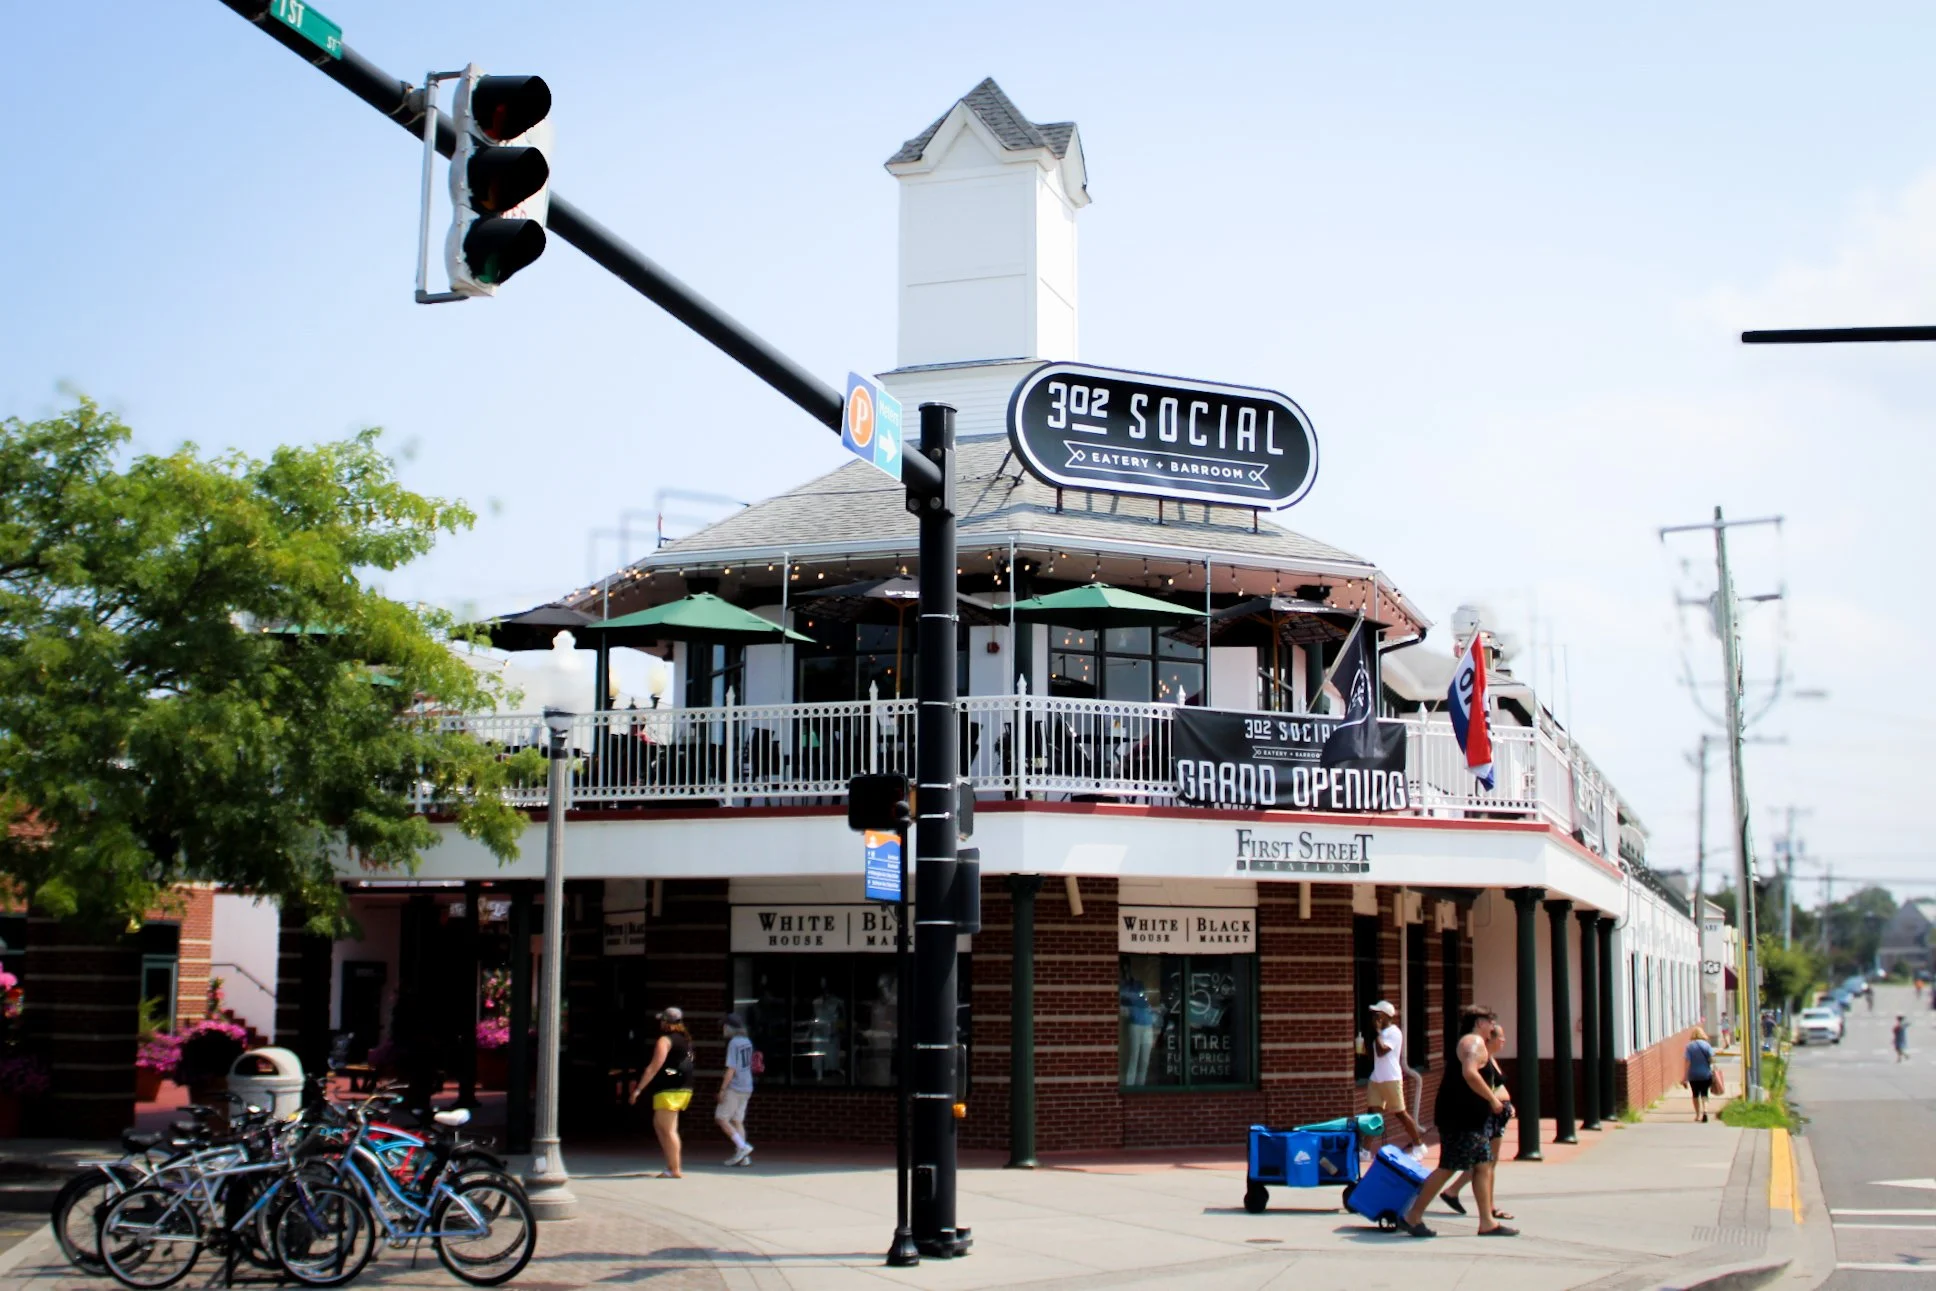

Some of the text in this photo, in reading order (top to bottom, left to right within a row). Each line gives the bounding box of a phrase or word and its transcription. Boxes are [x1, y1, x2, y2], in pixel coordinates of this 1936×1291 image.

[1047, 381, 1284, 455] 302 SOCIAL
[1092, 451, 1149, 469] EATERY
[1171, 461, 1243, 479] BARROOM
[1245, 719, 1337, 743] 302 SOCIA
[1294, 751, 1322, 759] BARROO
[1177, 760, 1407, 810] GRAND OPENING
[1236, 829, 1373, 861] FIRST STREET
[758, 912, 834, 931] WHITE
[1123, 916, 1250, 932] WHITE BLACK
[769, 935, 823, 946] HOUSE
[1131, 934, 1248, 943] HOUSE MARKET
[1167, 1065, 1231, 1076] PUCHASE
